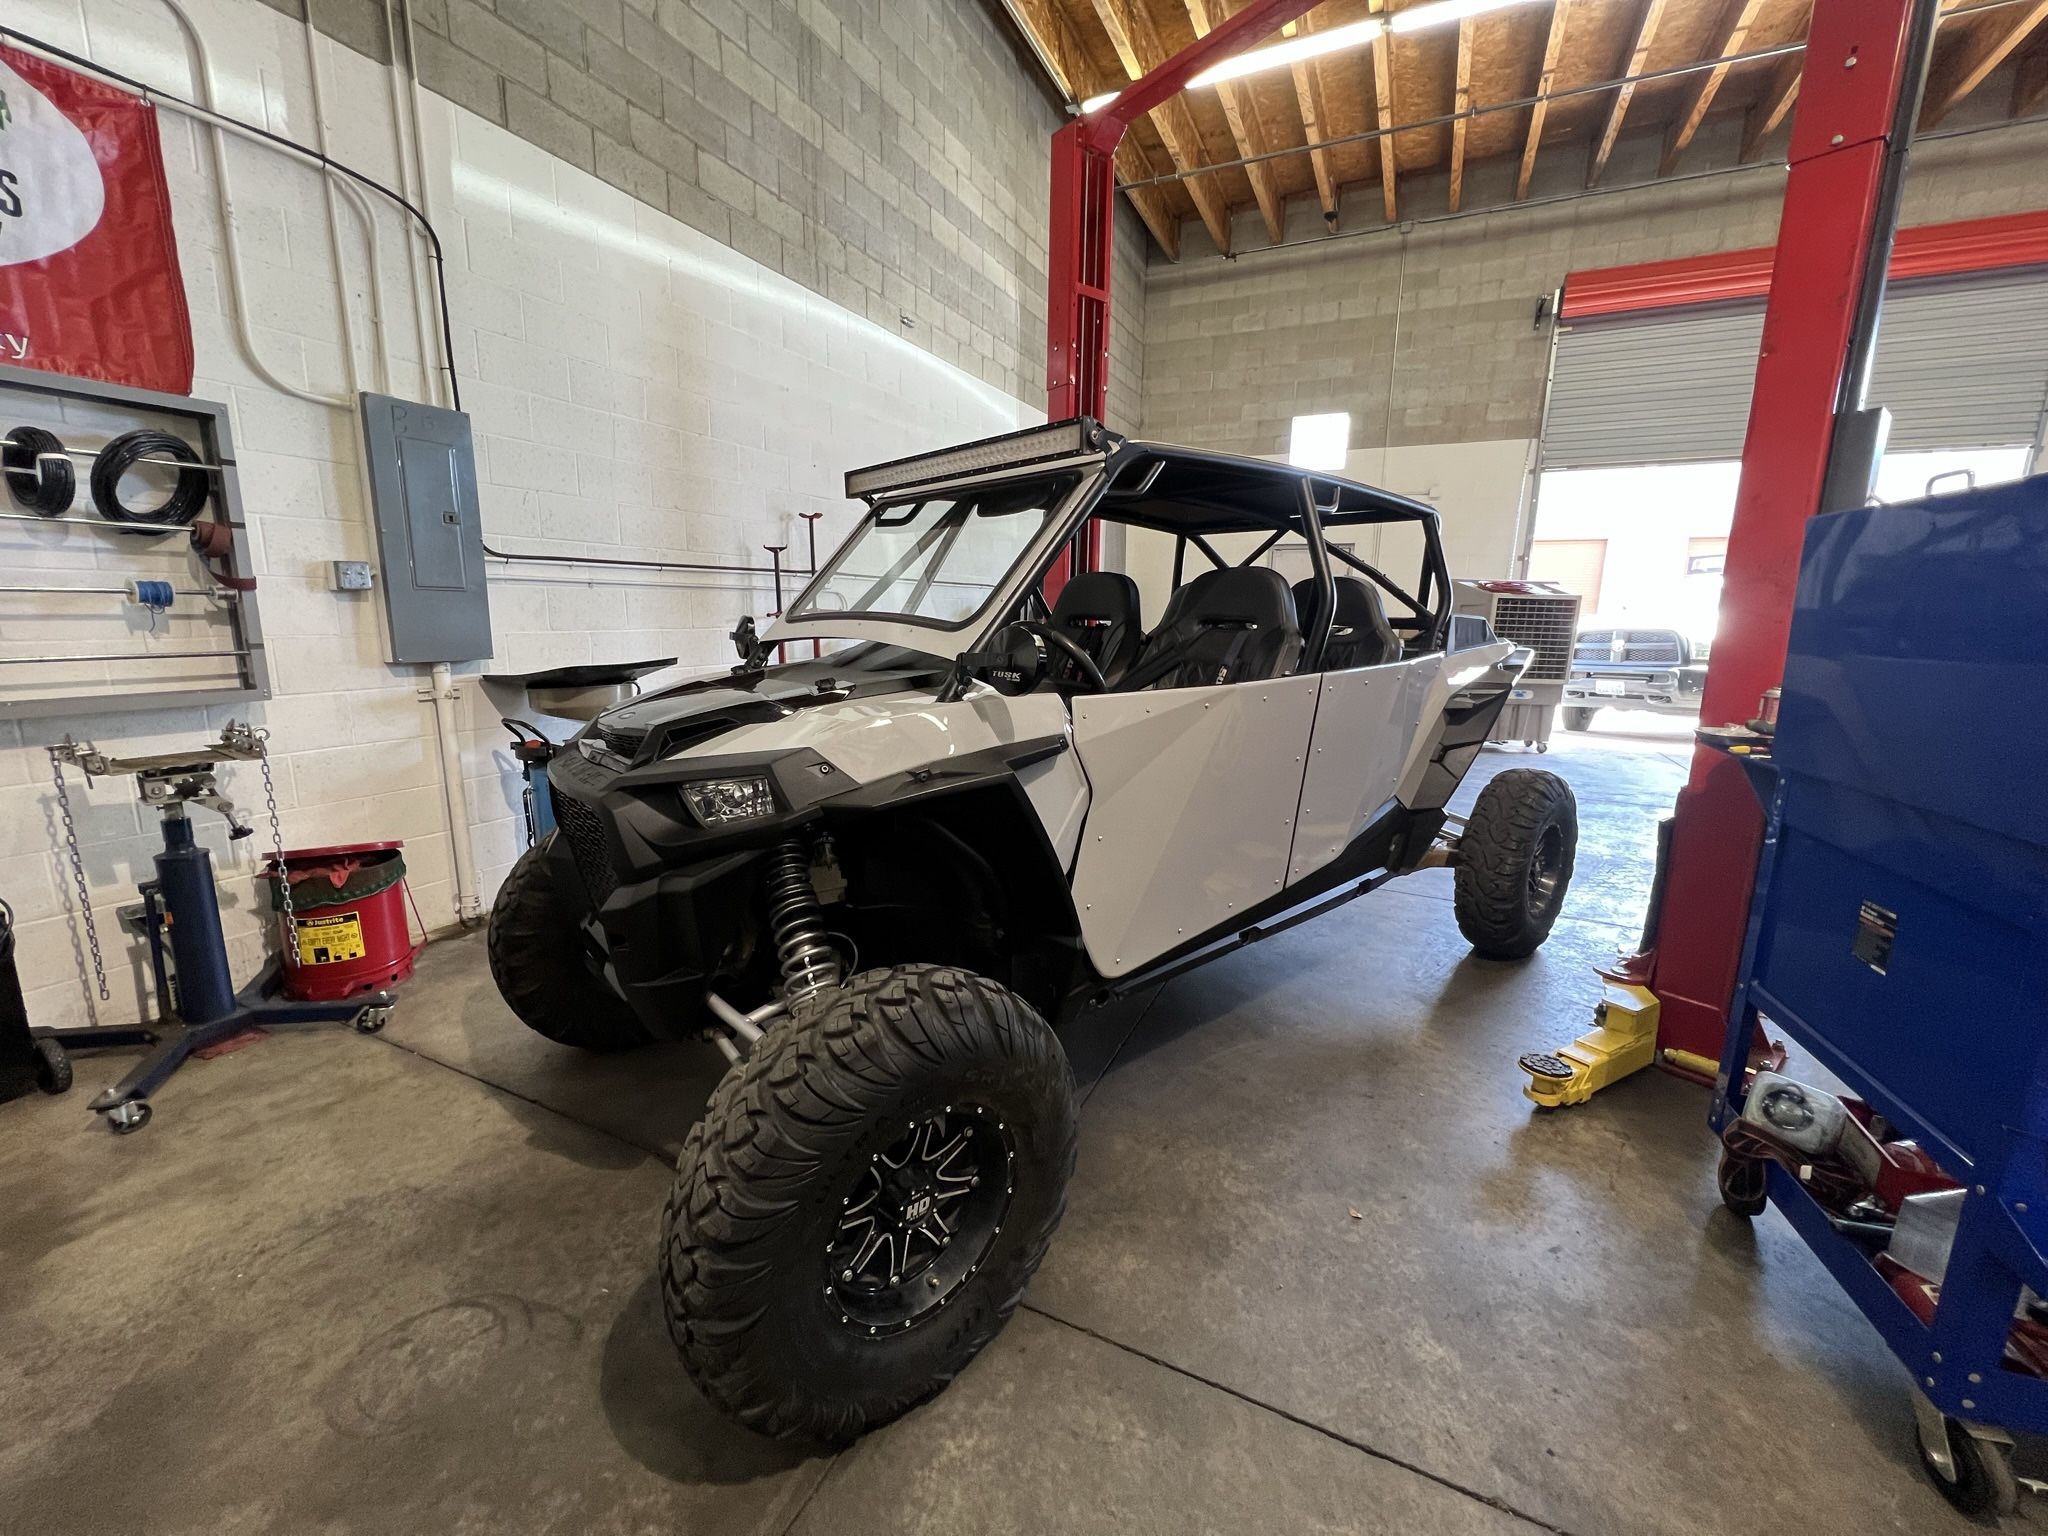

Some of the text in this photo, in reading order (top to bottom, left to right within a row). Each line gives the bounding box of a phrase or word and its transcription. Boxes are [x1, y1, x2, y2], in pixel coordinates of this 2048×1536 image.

[992, 670, 1022, 679] TUSK
[314, 917, 344, 926] Justrite
[905, 1196, 931, 1221] HD
